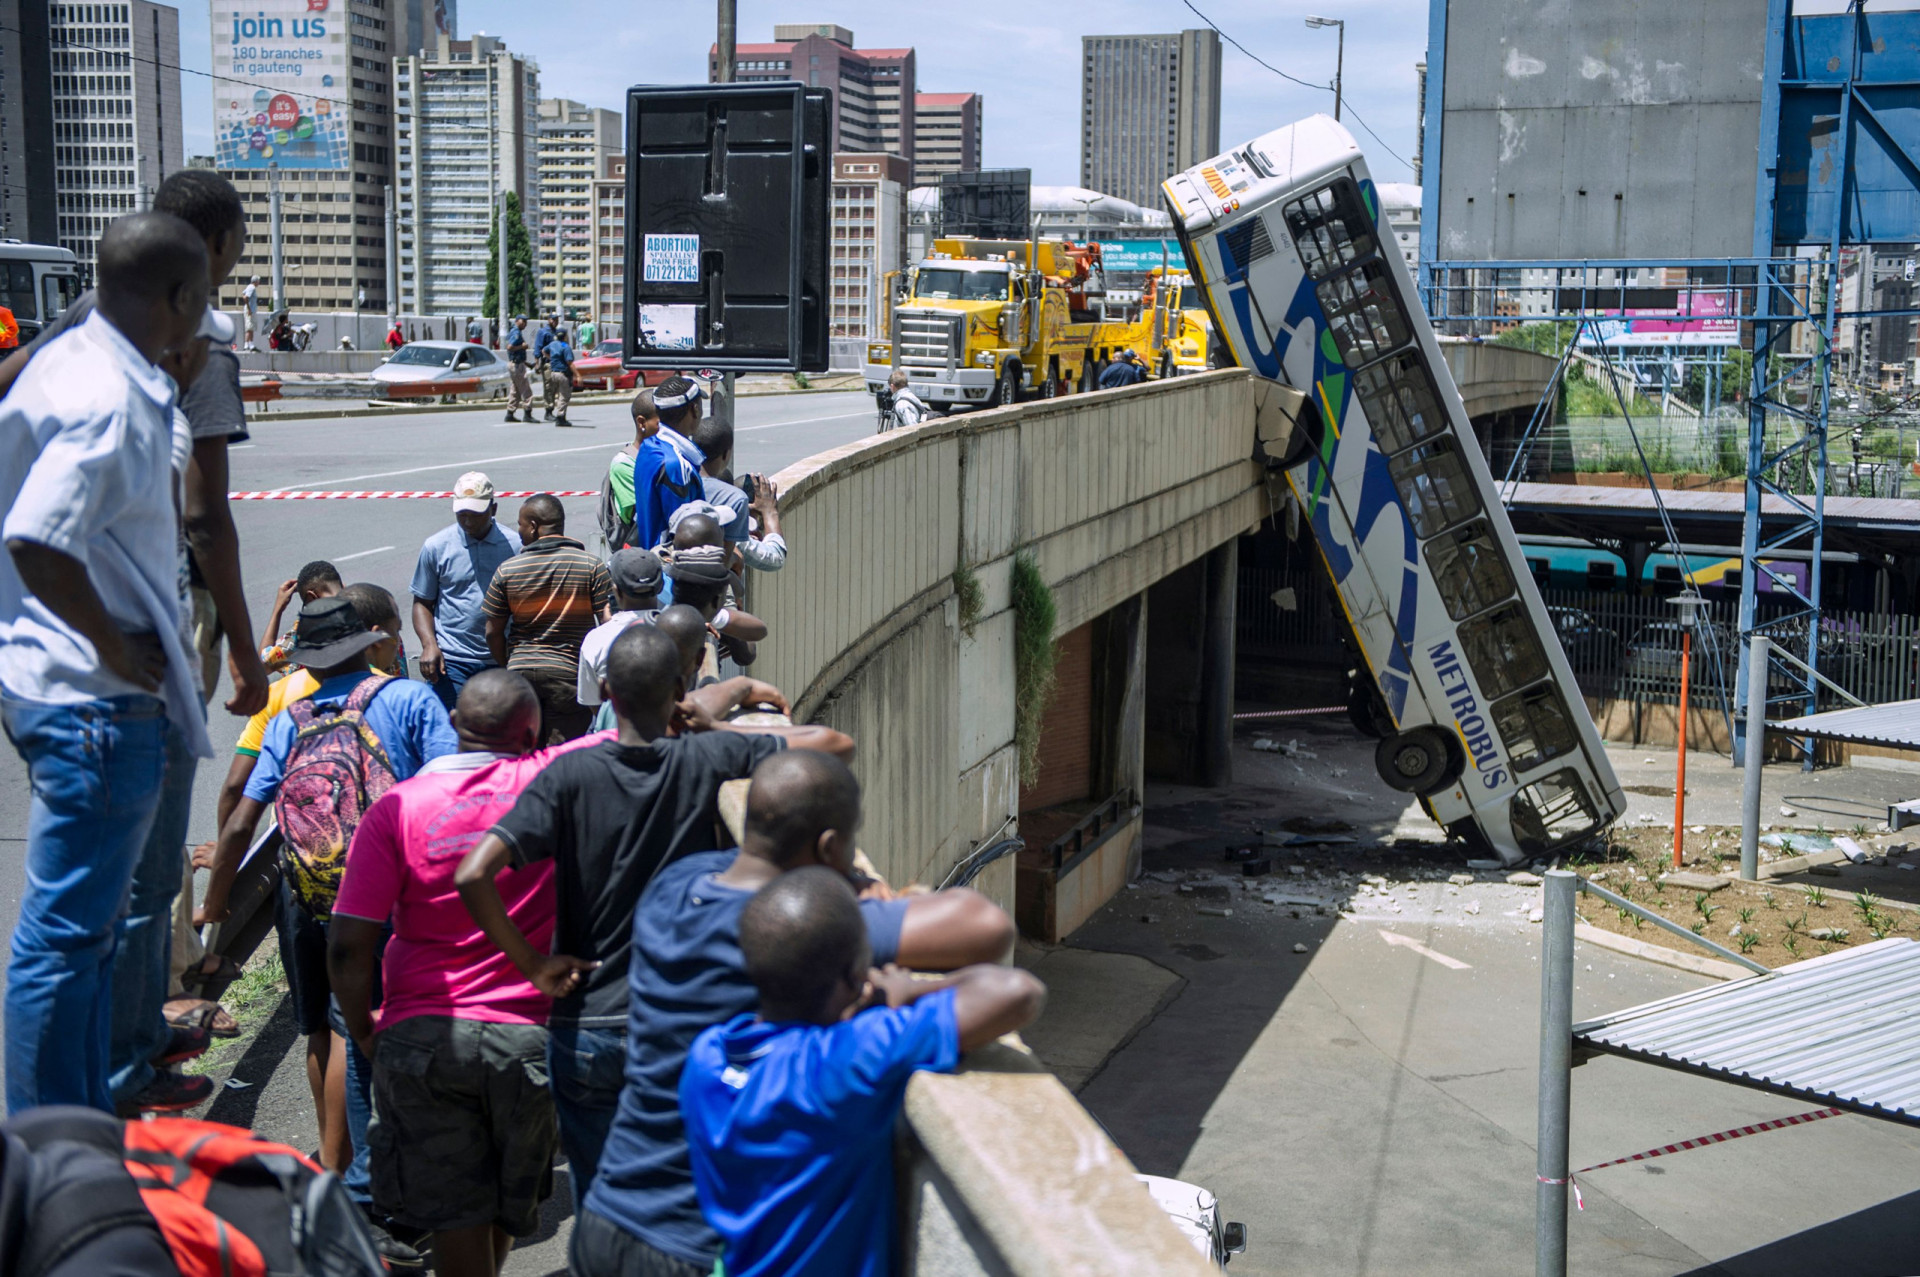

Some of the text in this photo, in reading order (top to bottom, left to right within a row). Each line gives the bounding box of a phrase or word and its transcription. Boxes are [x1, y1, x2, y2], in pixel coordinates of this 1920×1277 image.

[232, 12, 326, 45] join us
[233, 47, 323, 60] 180 branches
[233, 62, 303, 76] in gauteng
[275, 101, 291, 111] it's
[272, 112, 296, 122] easy
[647, 237, 698, 252] ABORTION
[673, 258, 693, 266] FREE
[646, 264, 698, 280] 071 221 2143
[1427, 640, 1507, 789] METROBUS
